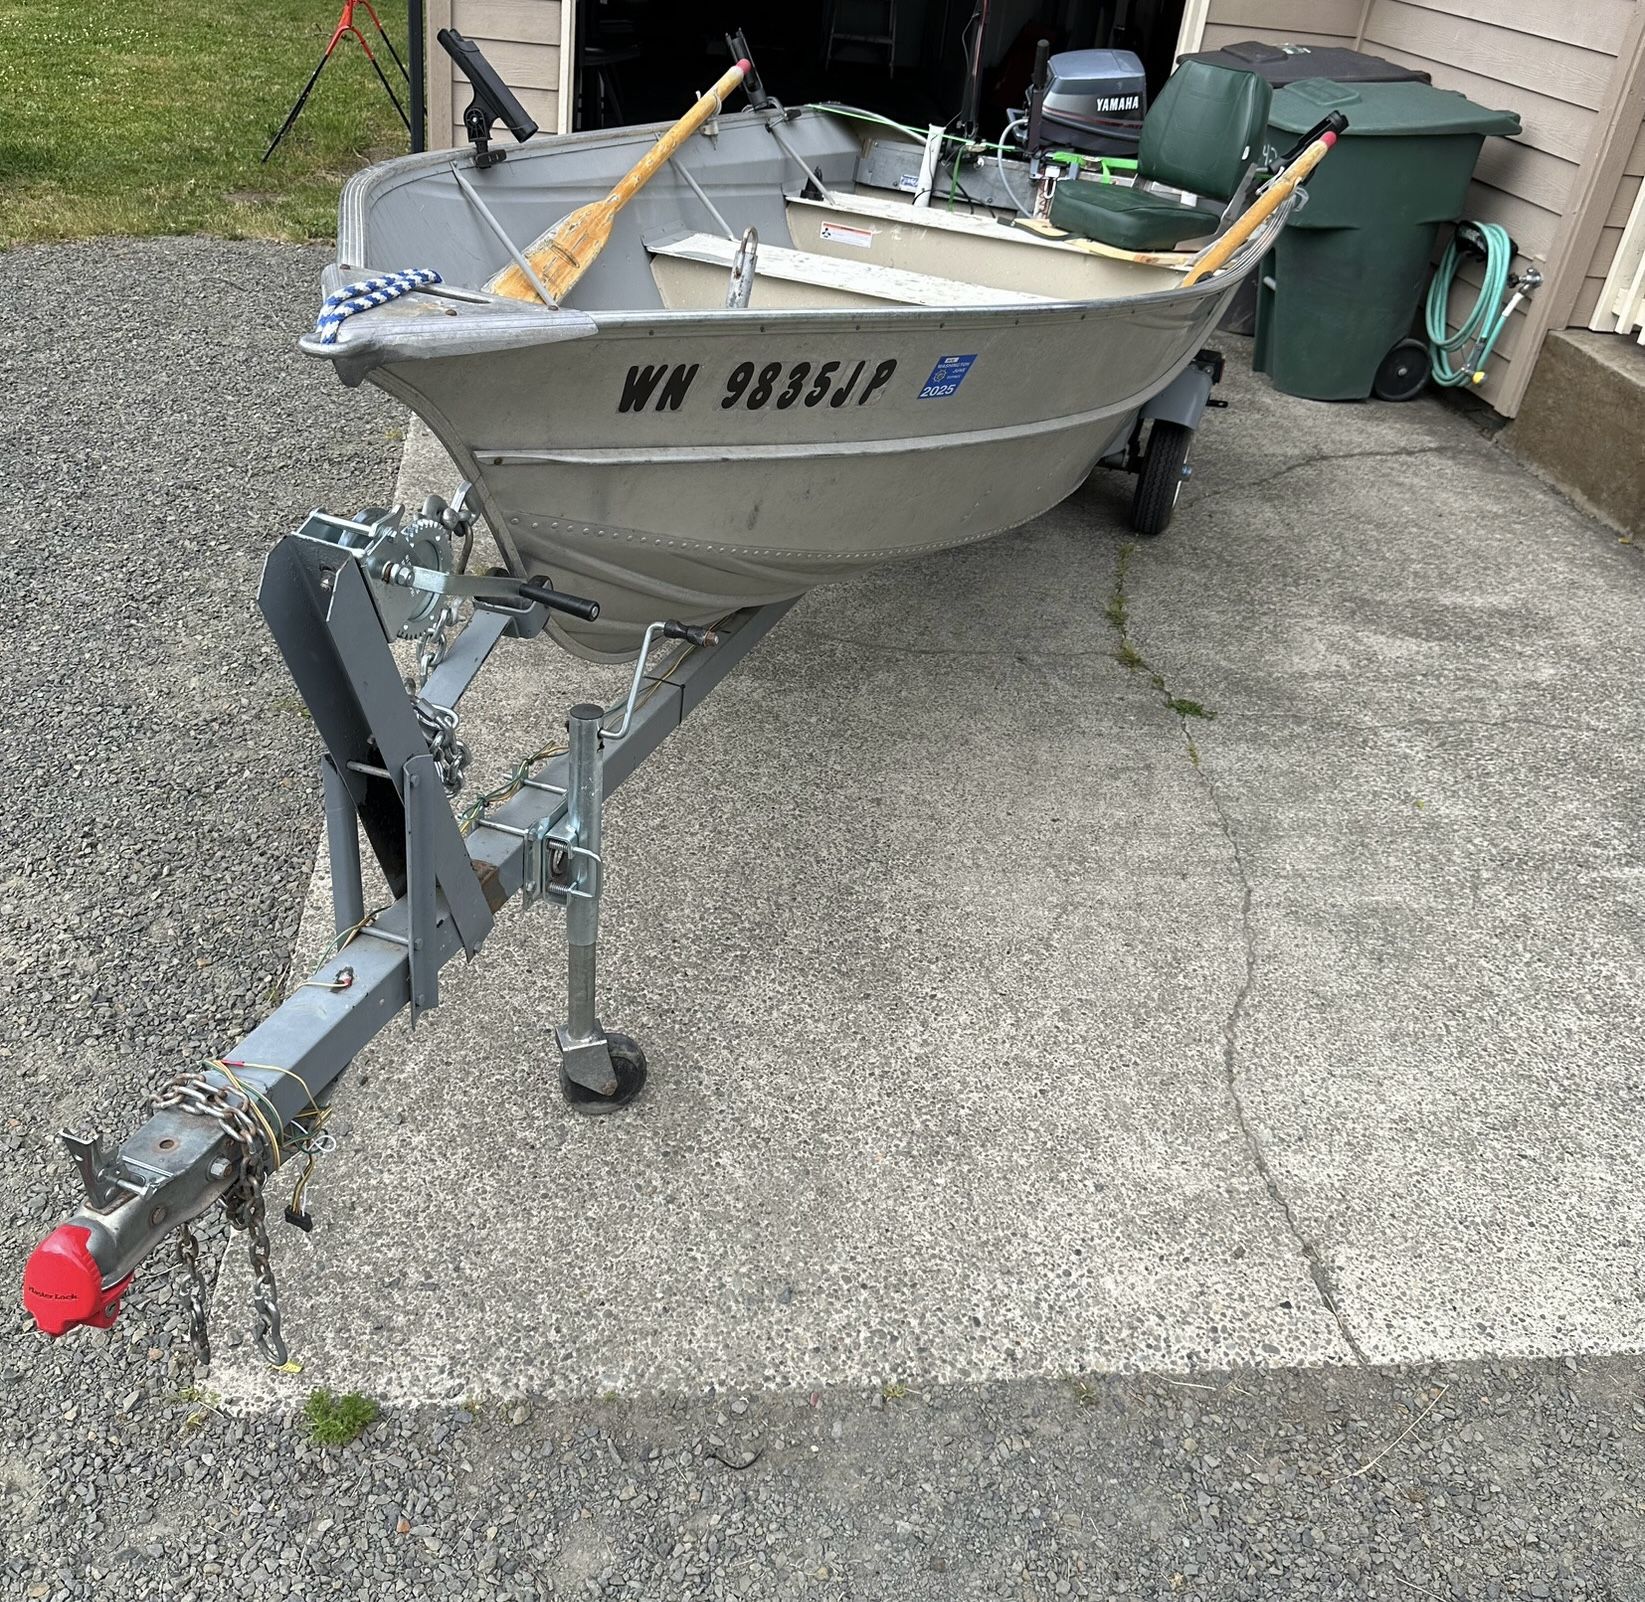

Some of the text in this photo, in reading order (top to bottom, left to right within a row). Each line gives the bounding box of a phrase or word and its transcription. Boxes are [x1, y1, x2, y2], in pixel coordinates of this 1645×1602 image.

[1096, 96, 1139, 112] YAMAHA
[617, 358, 898, 413] WN 9835JP
[919, 384, 957, 397] 2025
